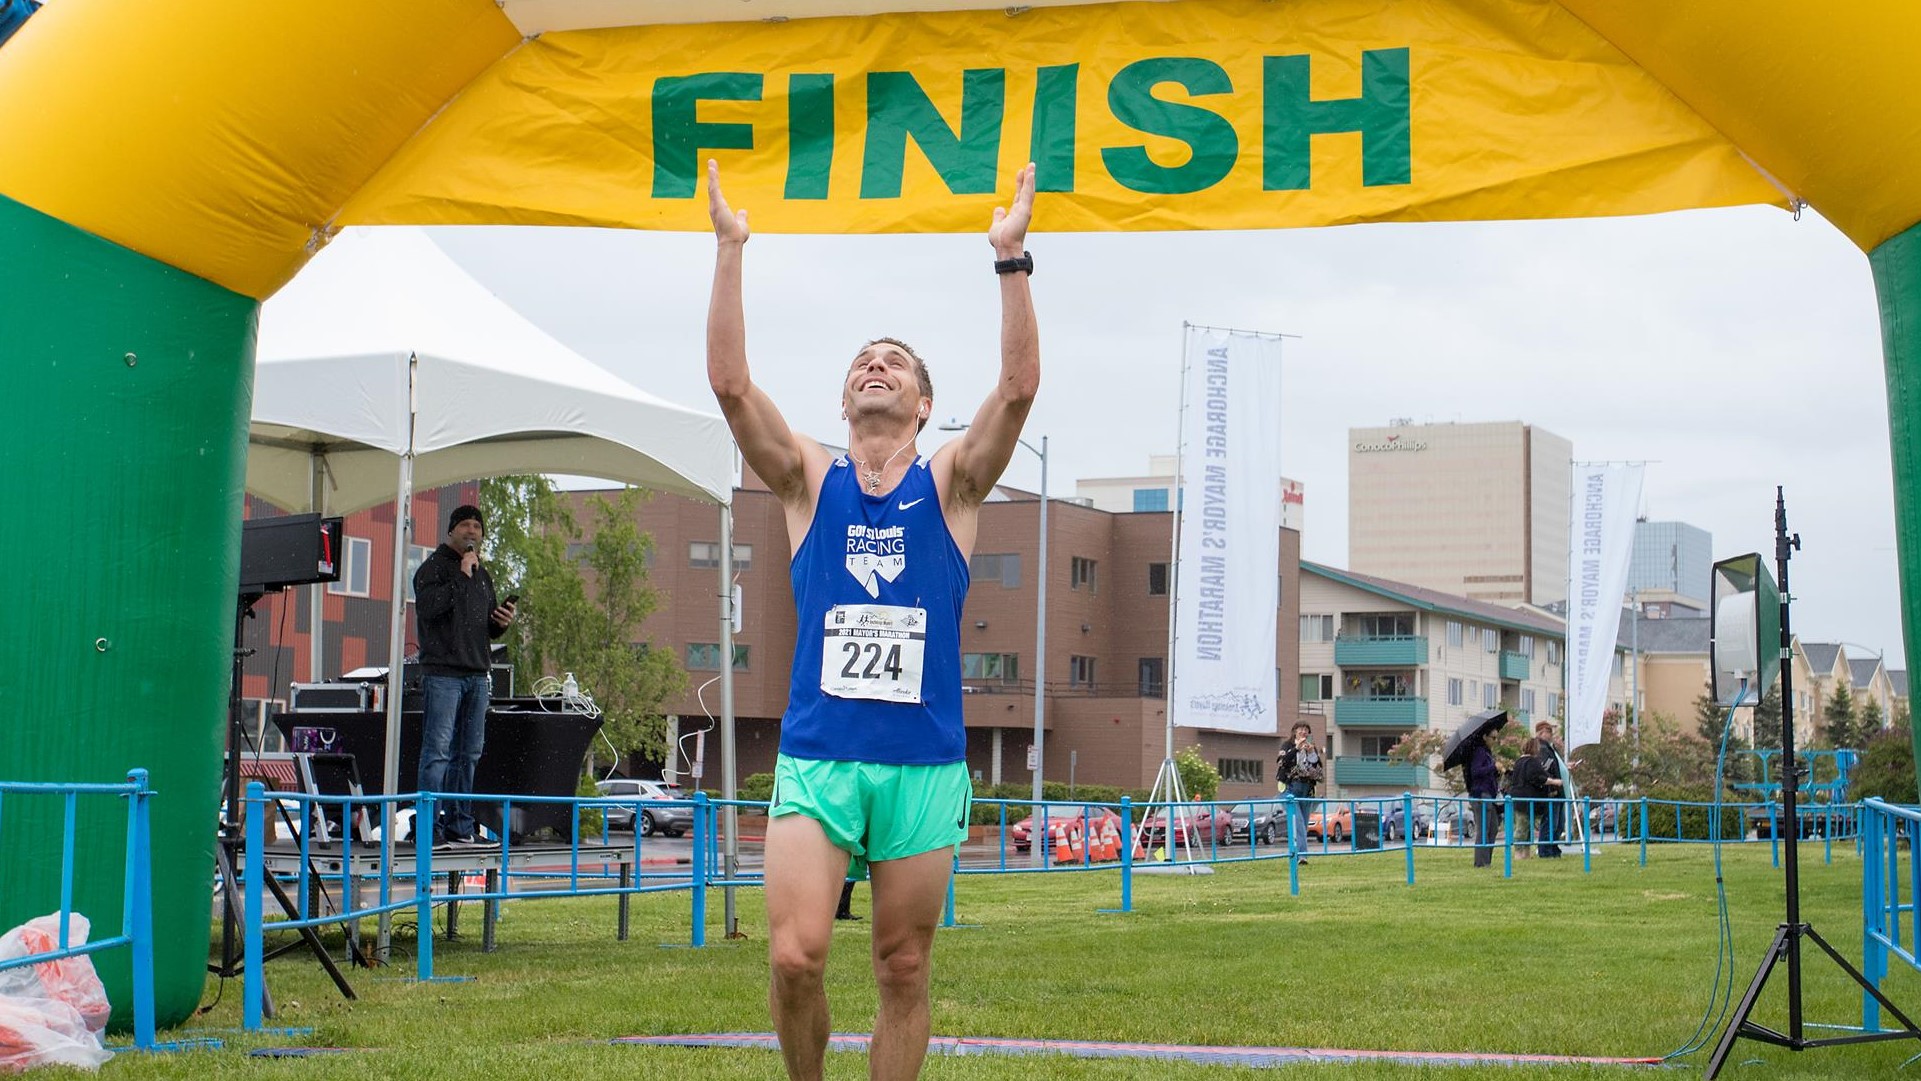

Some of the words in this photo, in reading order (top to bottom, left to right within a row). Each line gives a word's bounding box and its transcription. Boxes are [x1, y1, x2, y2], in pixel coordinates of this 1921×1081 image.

[651, 47, 1412, 199] FINISH
[1355, 440, 1427, 452] ConocoPhillips
[846, 538, 905, 555] RACING
[849, 557, 903, 568] TEAM
[853, 628, 878, 637] MAYOR'S
[879, 629, 910, 639] MARATHON
[840, 641, 903, 681] 224
